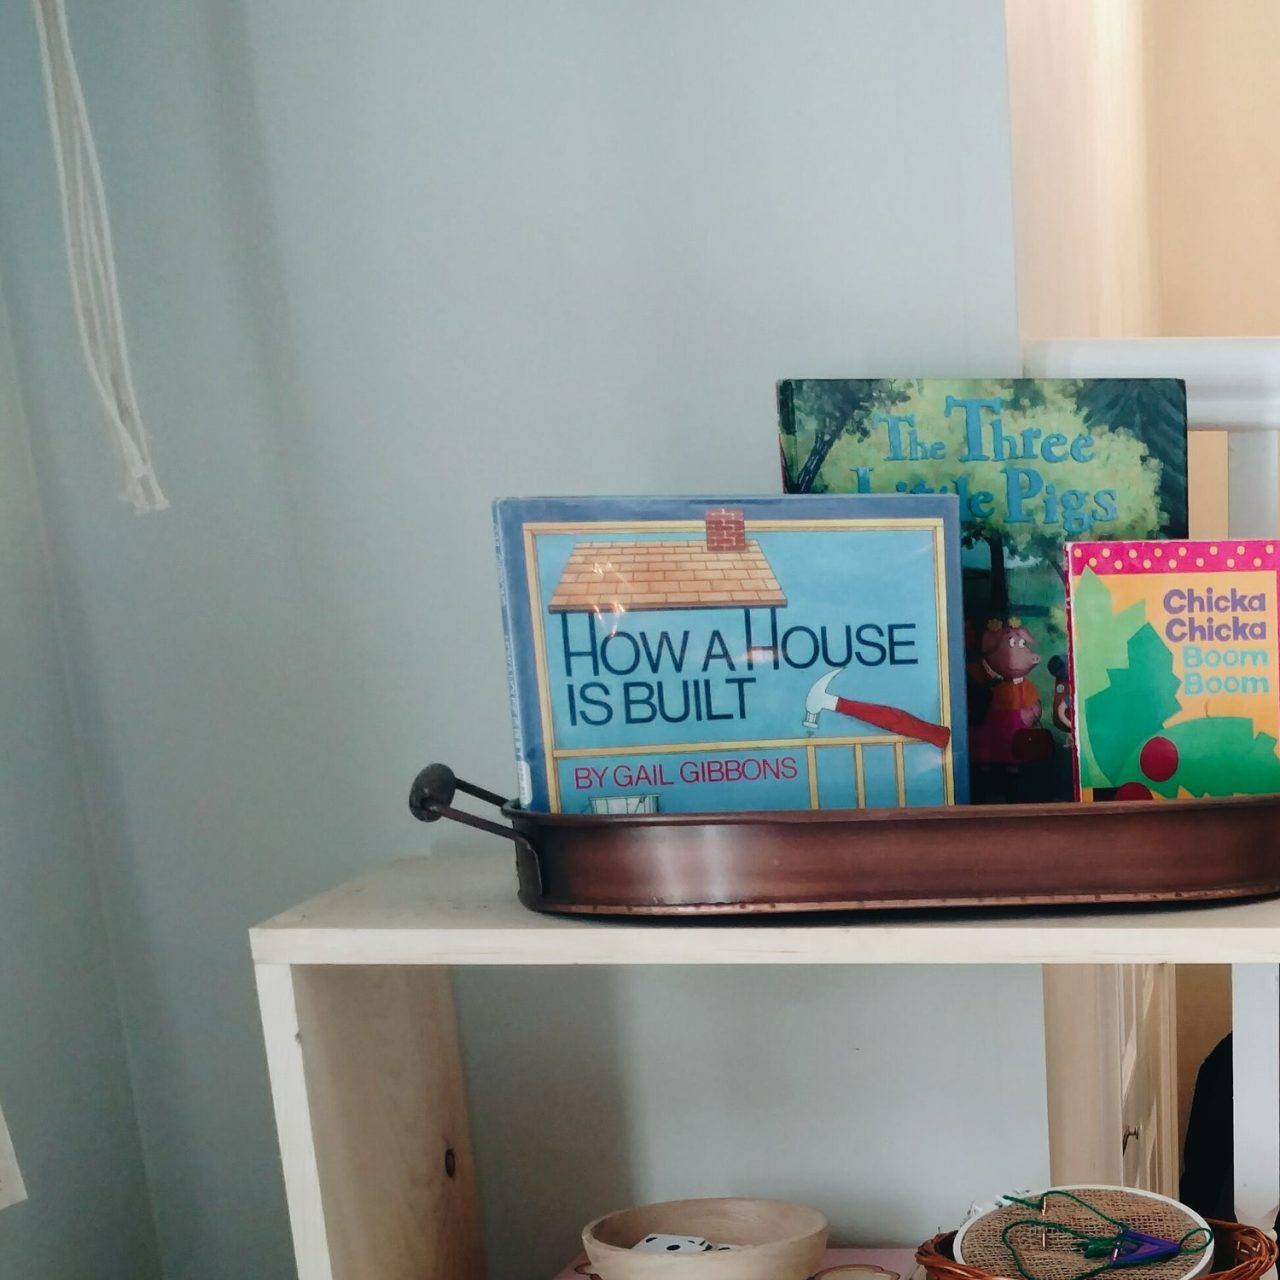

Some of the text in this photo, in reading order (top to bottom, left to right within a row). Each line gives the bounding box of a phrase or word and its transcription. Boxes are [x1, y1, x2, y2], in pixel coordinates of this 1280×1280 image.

[873, 394, 1096, 464] The Three
[1000, 465, 1120, 536] Pigs
[1163, 586, 1267, 615] Chicka
[561, 607, 919, 677] HOW A HOUSE
[1165, 616, 1267, 643] Chicka
[1182, 645, 1270, 668] Boom
[1183, 671, 1271, 696] Boom
[568, 677, 757, 727] IS BUILT
[575, 757, 798, 789] BY GAIL GIBBONS
